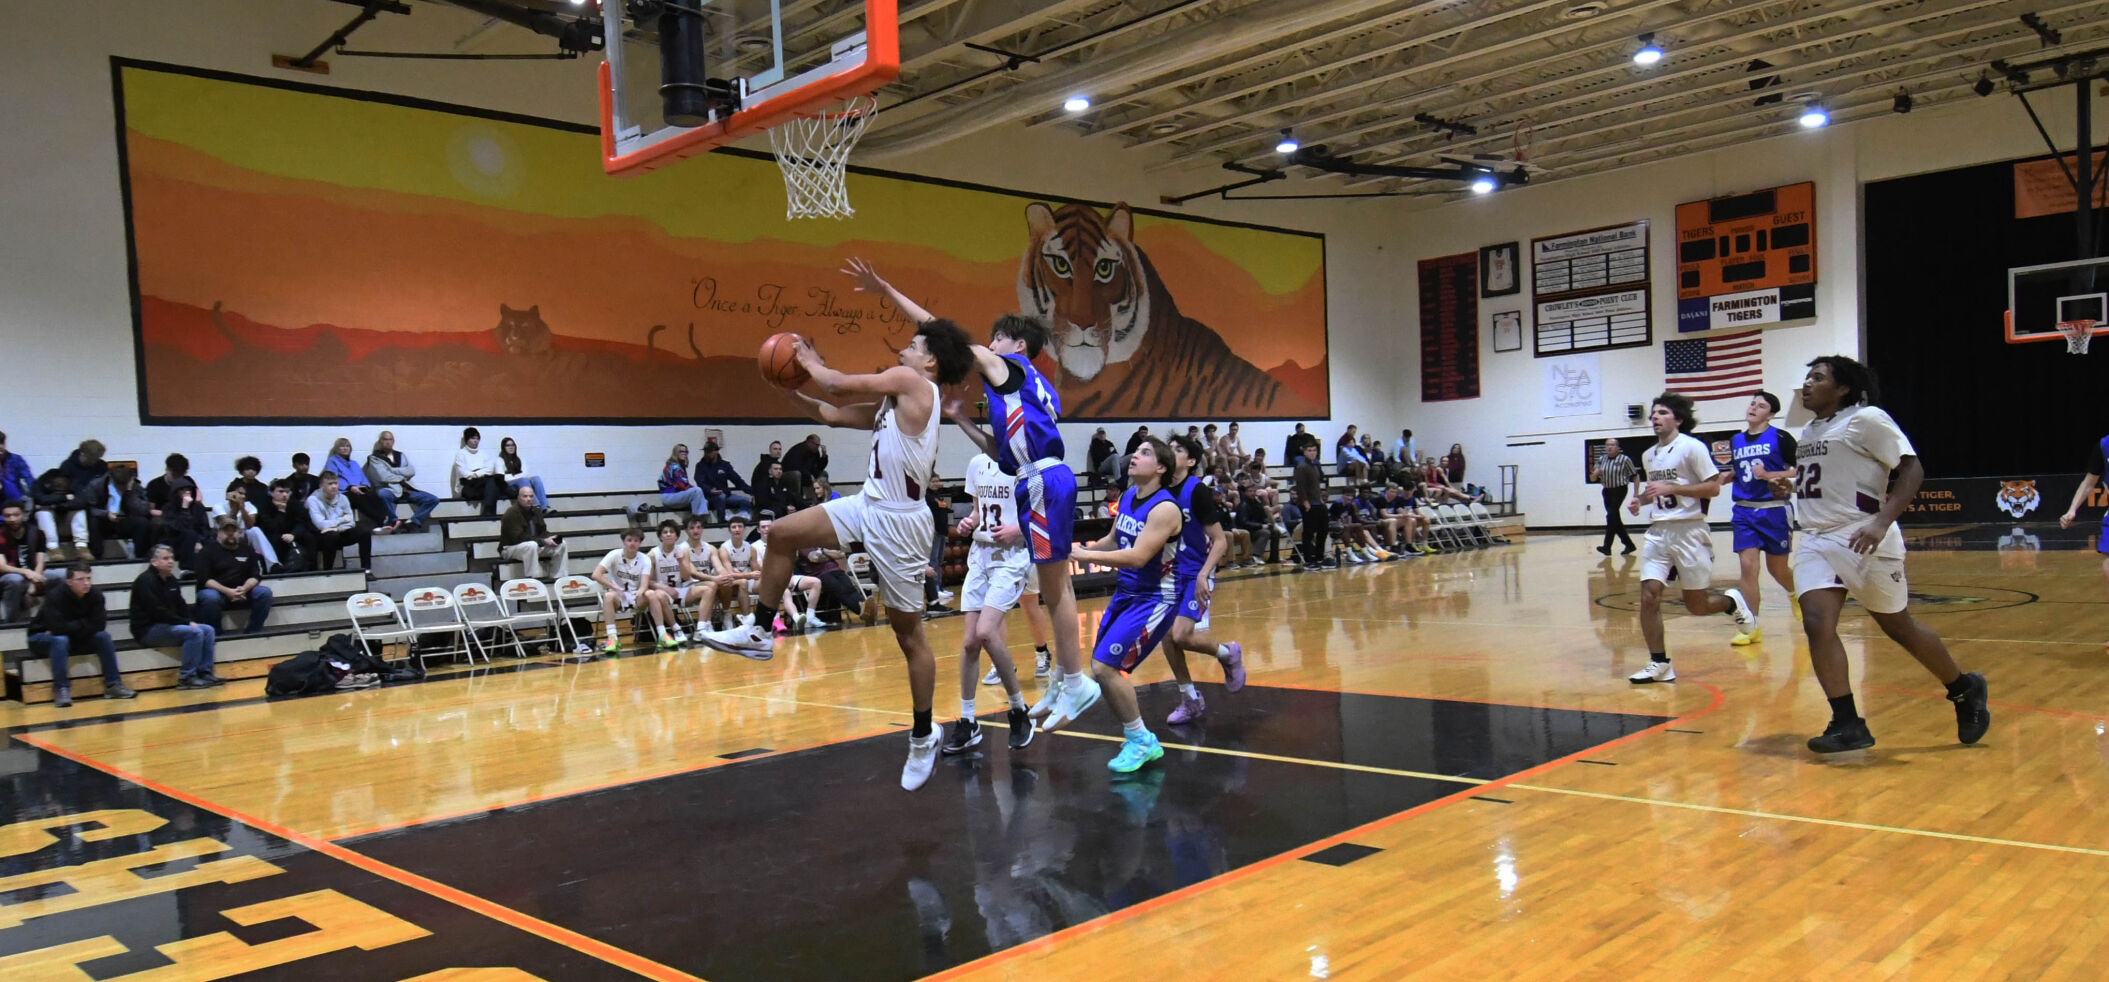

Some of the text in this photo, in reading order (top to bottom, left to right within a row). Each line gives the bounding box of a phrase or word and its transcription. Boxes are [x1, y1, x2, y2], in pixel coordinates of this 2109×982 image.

[1773, 211, 1806, 226] GUEST
[1682, 226, 1715, 240] TIGERS
[741, 302, 751, 313] a
[1712, 295, 1777, 312] FARMINGTON
[1726, 309, 1763, 322] TIGERS
[1928, 503, 1962, 512] TIGER
[980, 504, 1001, 533] 13
